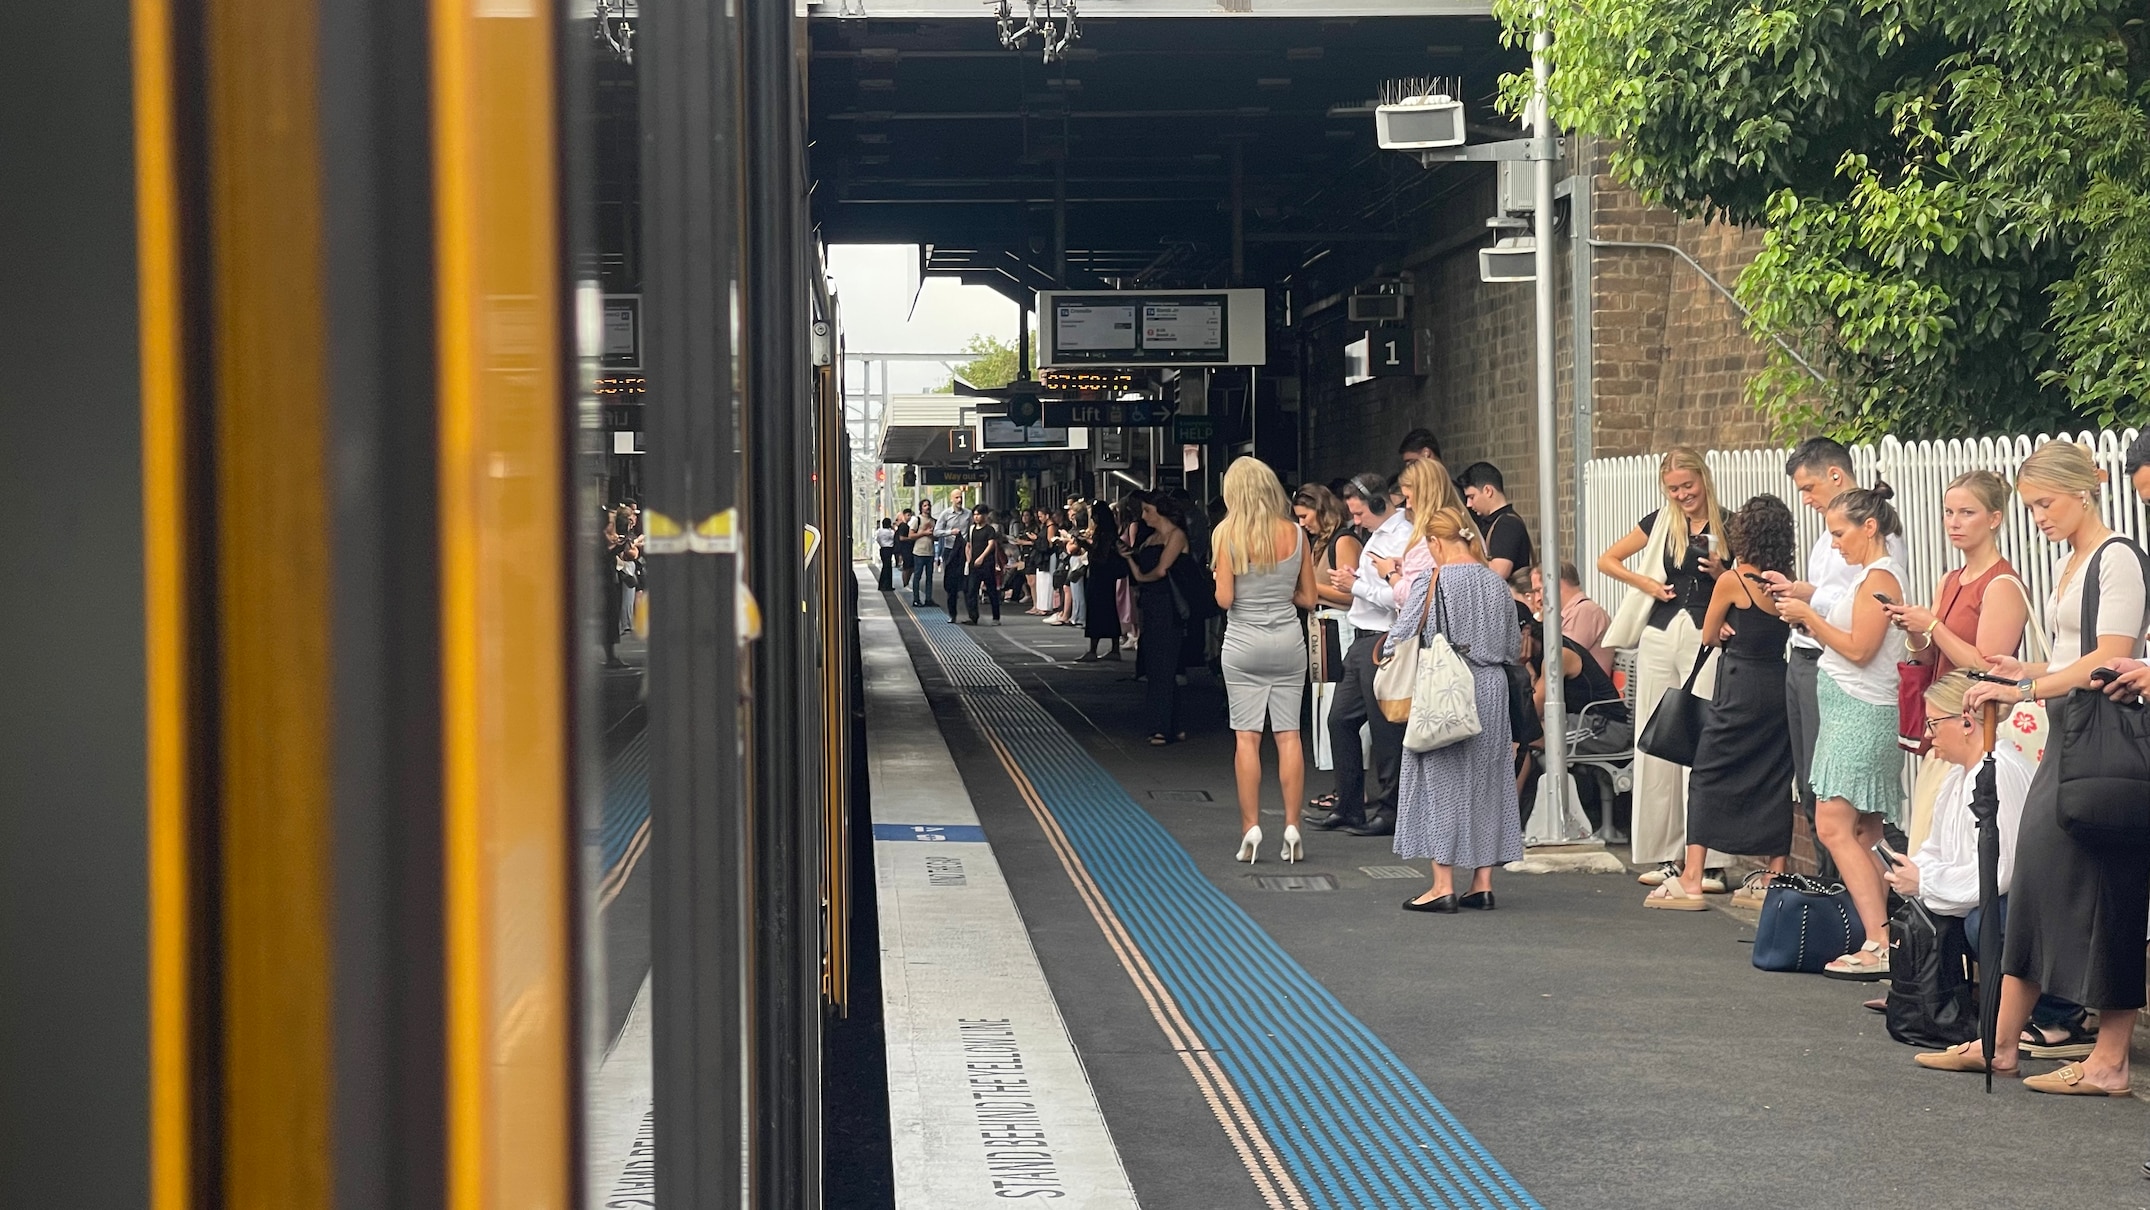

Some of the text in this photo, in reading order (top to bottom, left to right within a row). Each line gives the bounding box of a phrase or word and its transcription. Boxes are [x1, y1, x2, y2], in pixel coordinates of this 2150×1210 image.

[1385, 340, 1400, 365] 1
[1072, 407, 1101, 422] Lift
[1179, 427, 1213, 440] HELP
[958, 434, 967, 448] 1
[943, 472, 961, 481] Way
[1311, 634, 1319, 655] Chloé
[927, 865, 964, 873] THE
[929, 873, 967, 886] MIND
[958, 1018, 1066, 1198] STAND BEHIND THE YELLOW LINE
